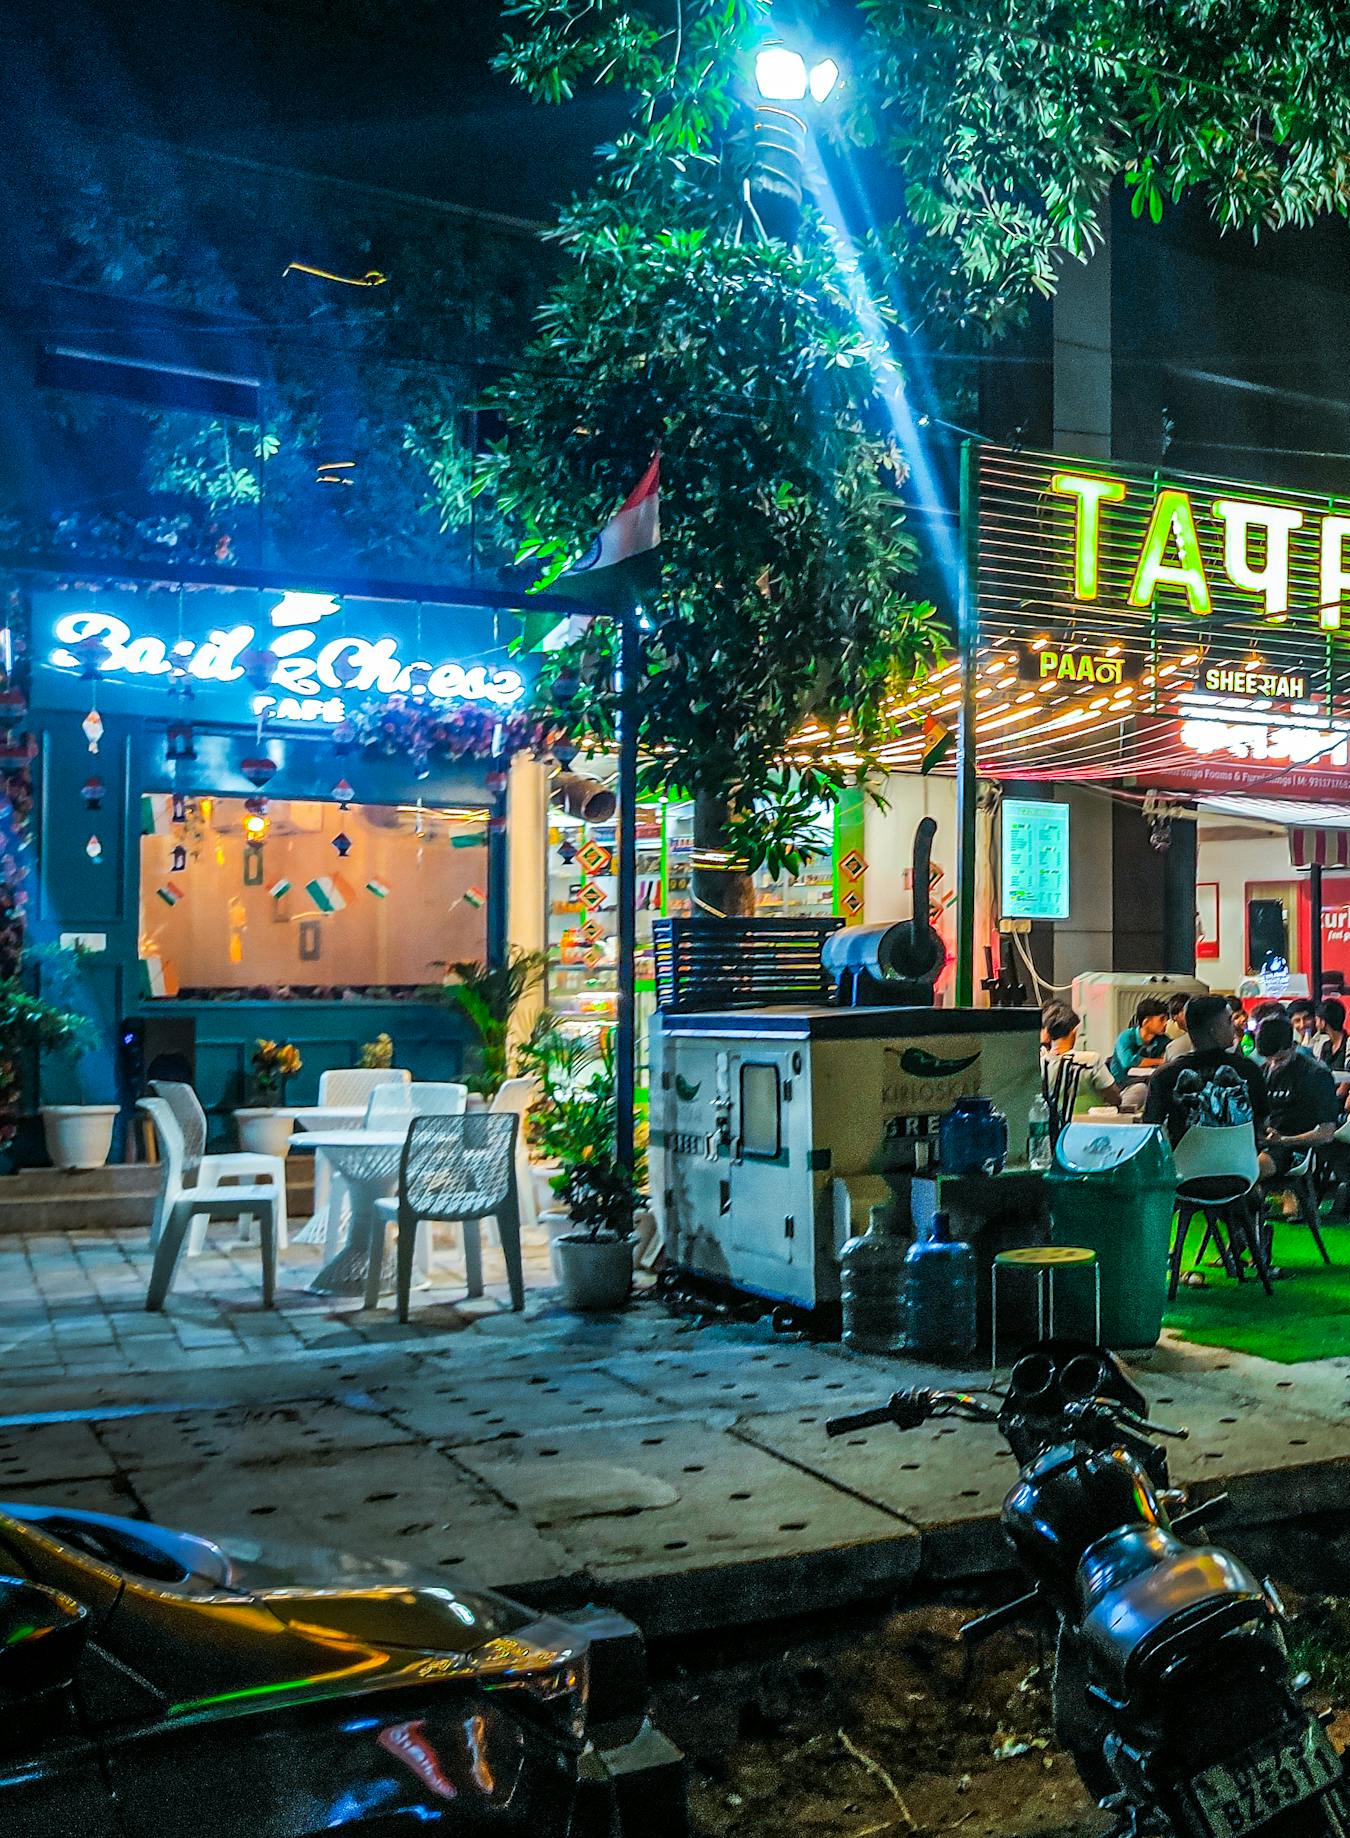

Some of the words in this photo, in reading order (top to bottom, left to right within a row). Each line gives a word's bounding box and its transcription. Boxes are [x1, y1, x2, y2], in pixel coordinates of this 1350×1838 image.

[1204, 768, 1233, 782] Foams
[1233, 771, 1241, 782] &
[884, 1115, 941, 1137] GRE
